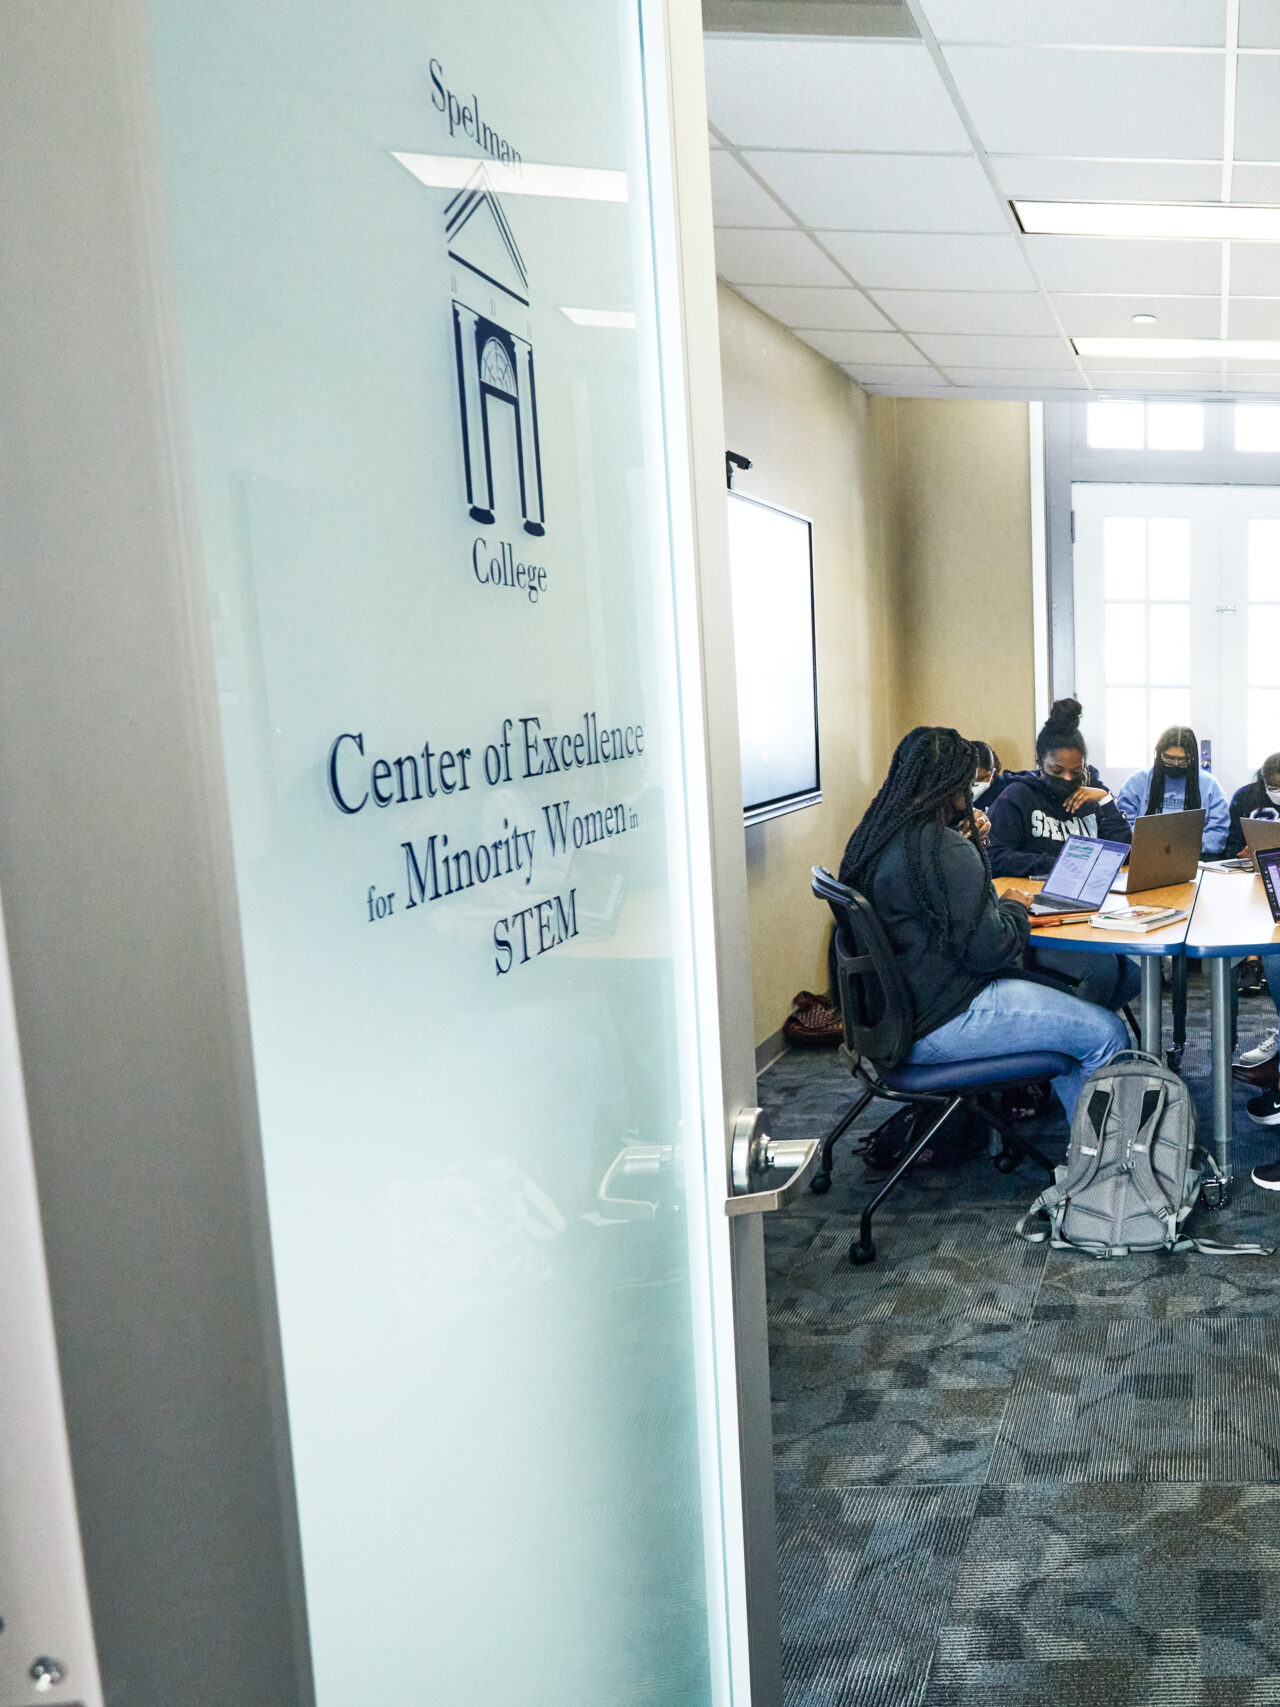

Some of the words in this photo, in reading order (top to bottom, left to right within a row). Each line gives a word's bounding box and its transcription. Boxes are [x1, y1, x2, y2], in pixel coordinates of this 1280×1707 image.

[430, 58, 522, 176] Spelman
[473, 537, 547, 603] College
[330, 732, 471, 814] Center
[484, 719, 512, 785] of
[519, 712, 645, 780] Excellence
[367, 885, 396, 922] for
[401, 818, 536, 910] Minority
[542, 800, 626, 857] Women
[629, 808, 639, 829] in
[493, 888, 579, 976] STEM
